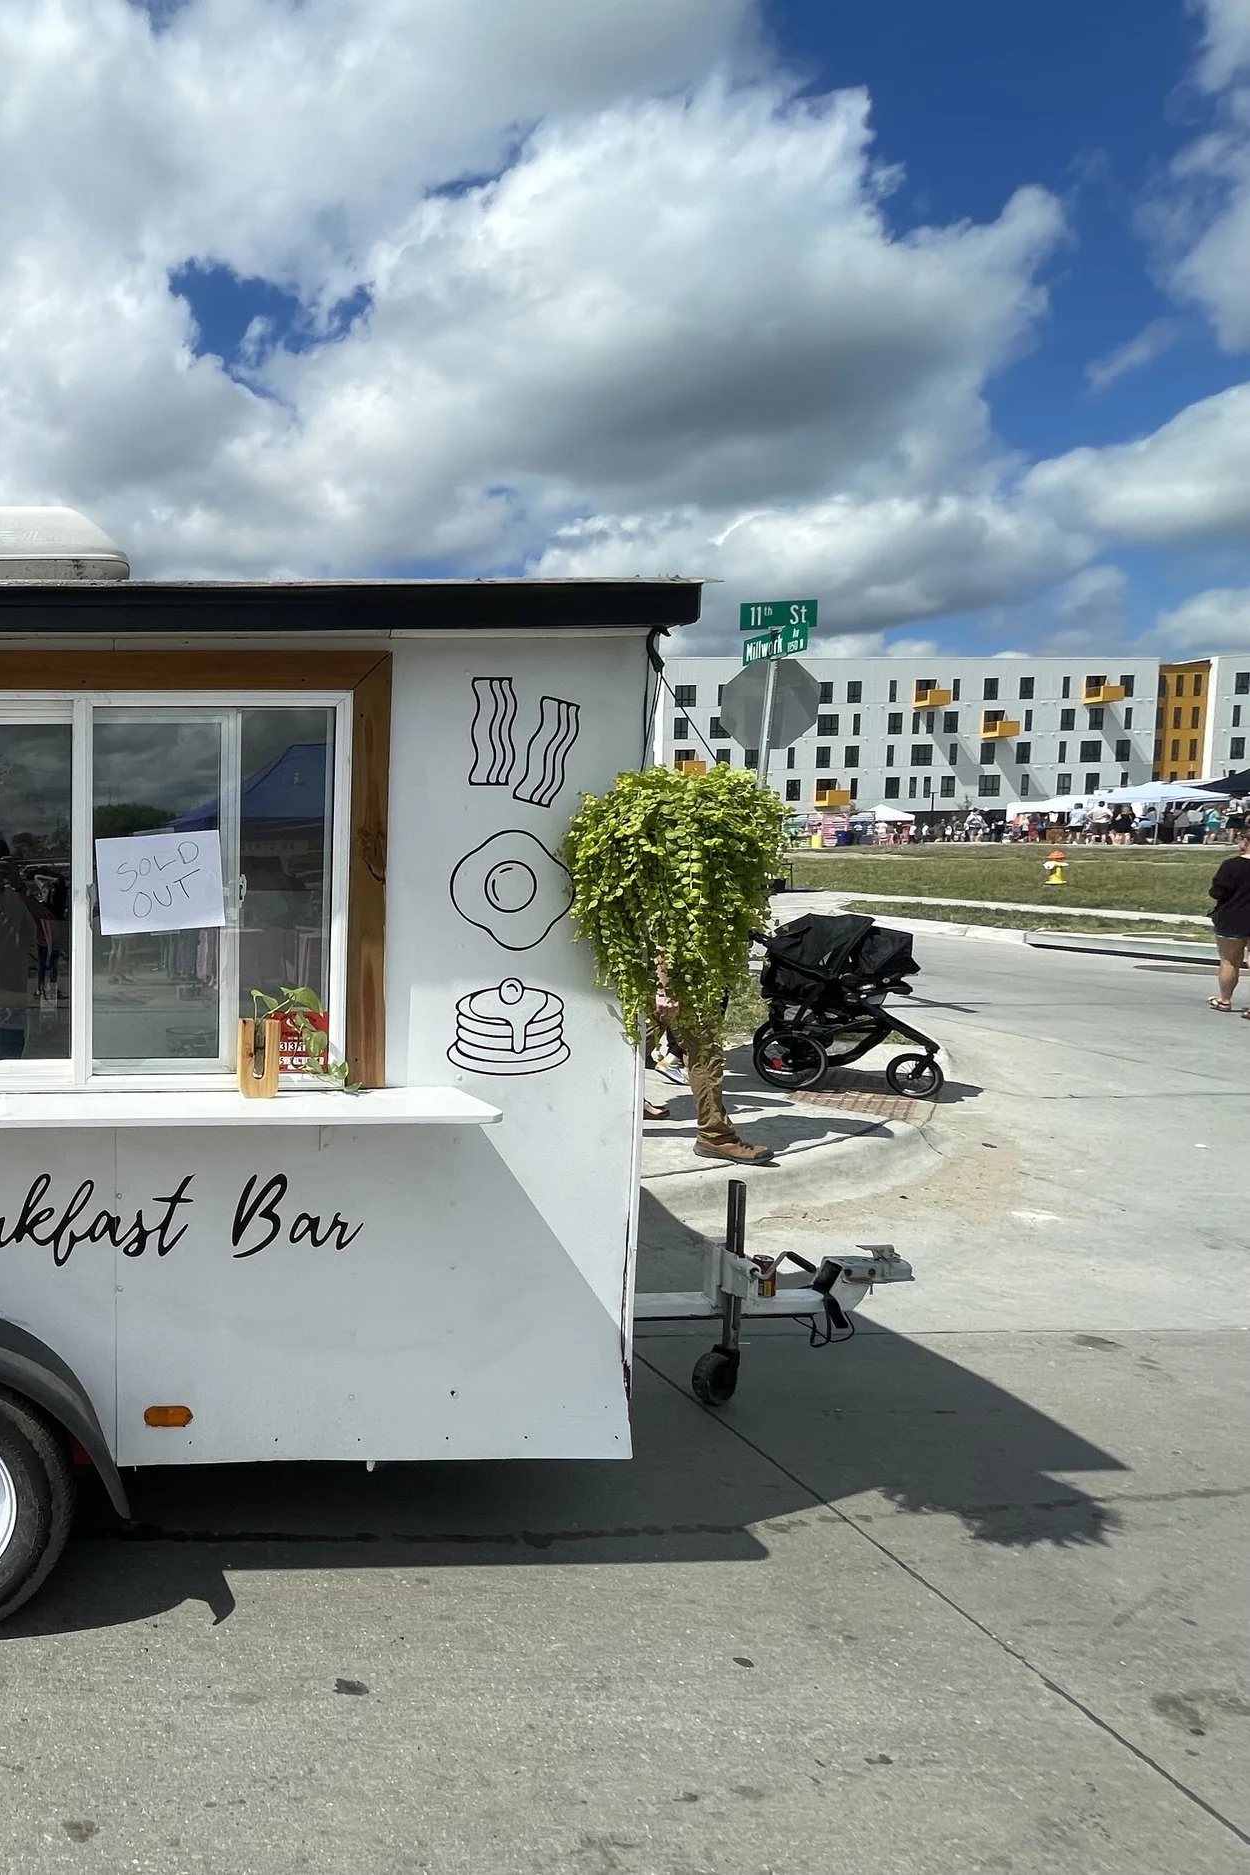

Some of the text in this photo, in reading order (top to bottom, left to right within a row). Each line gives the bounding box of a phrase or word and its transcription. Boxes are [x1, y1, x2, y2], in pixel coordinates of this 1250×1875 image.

[750, 604, 807, 626] 11th St
[746, 634, 783, 662] Millwork
[117, 841, 200, 892] SOLD
[132, 868, 200, 918] OUT
[232, 1174, 363, 1258] Bar
